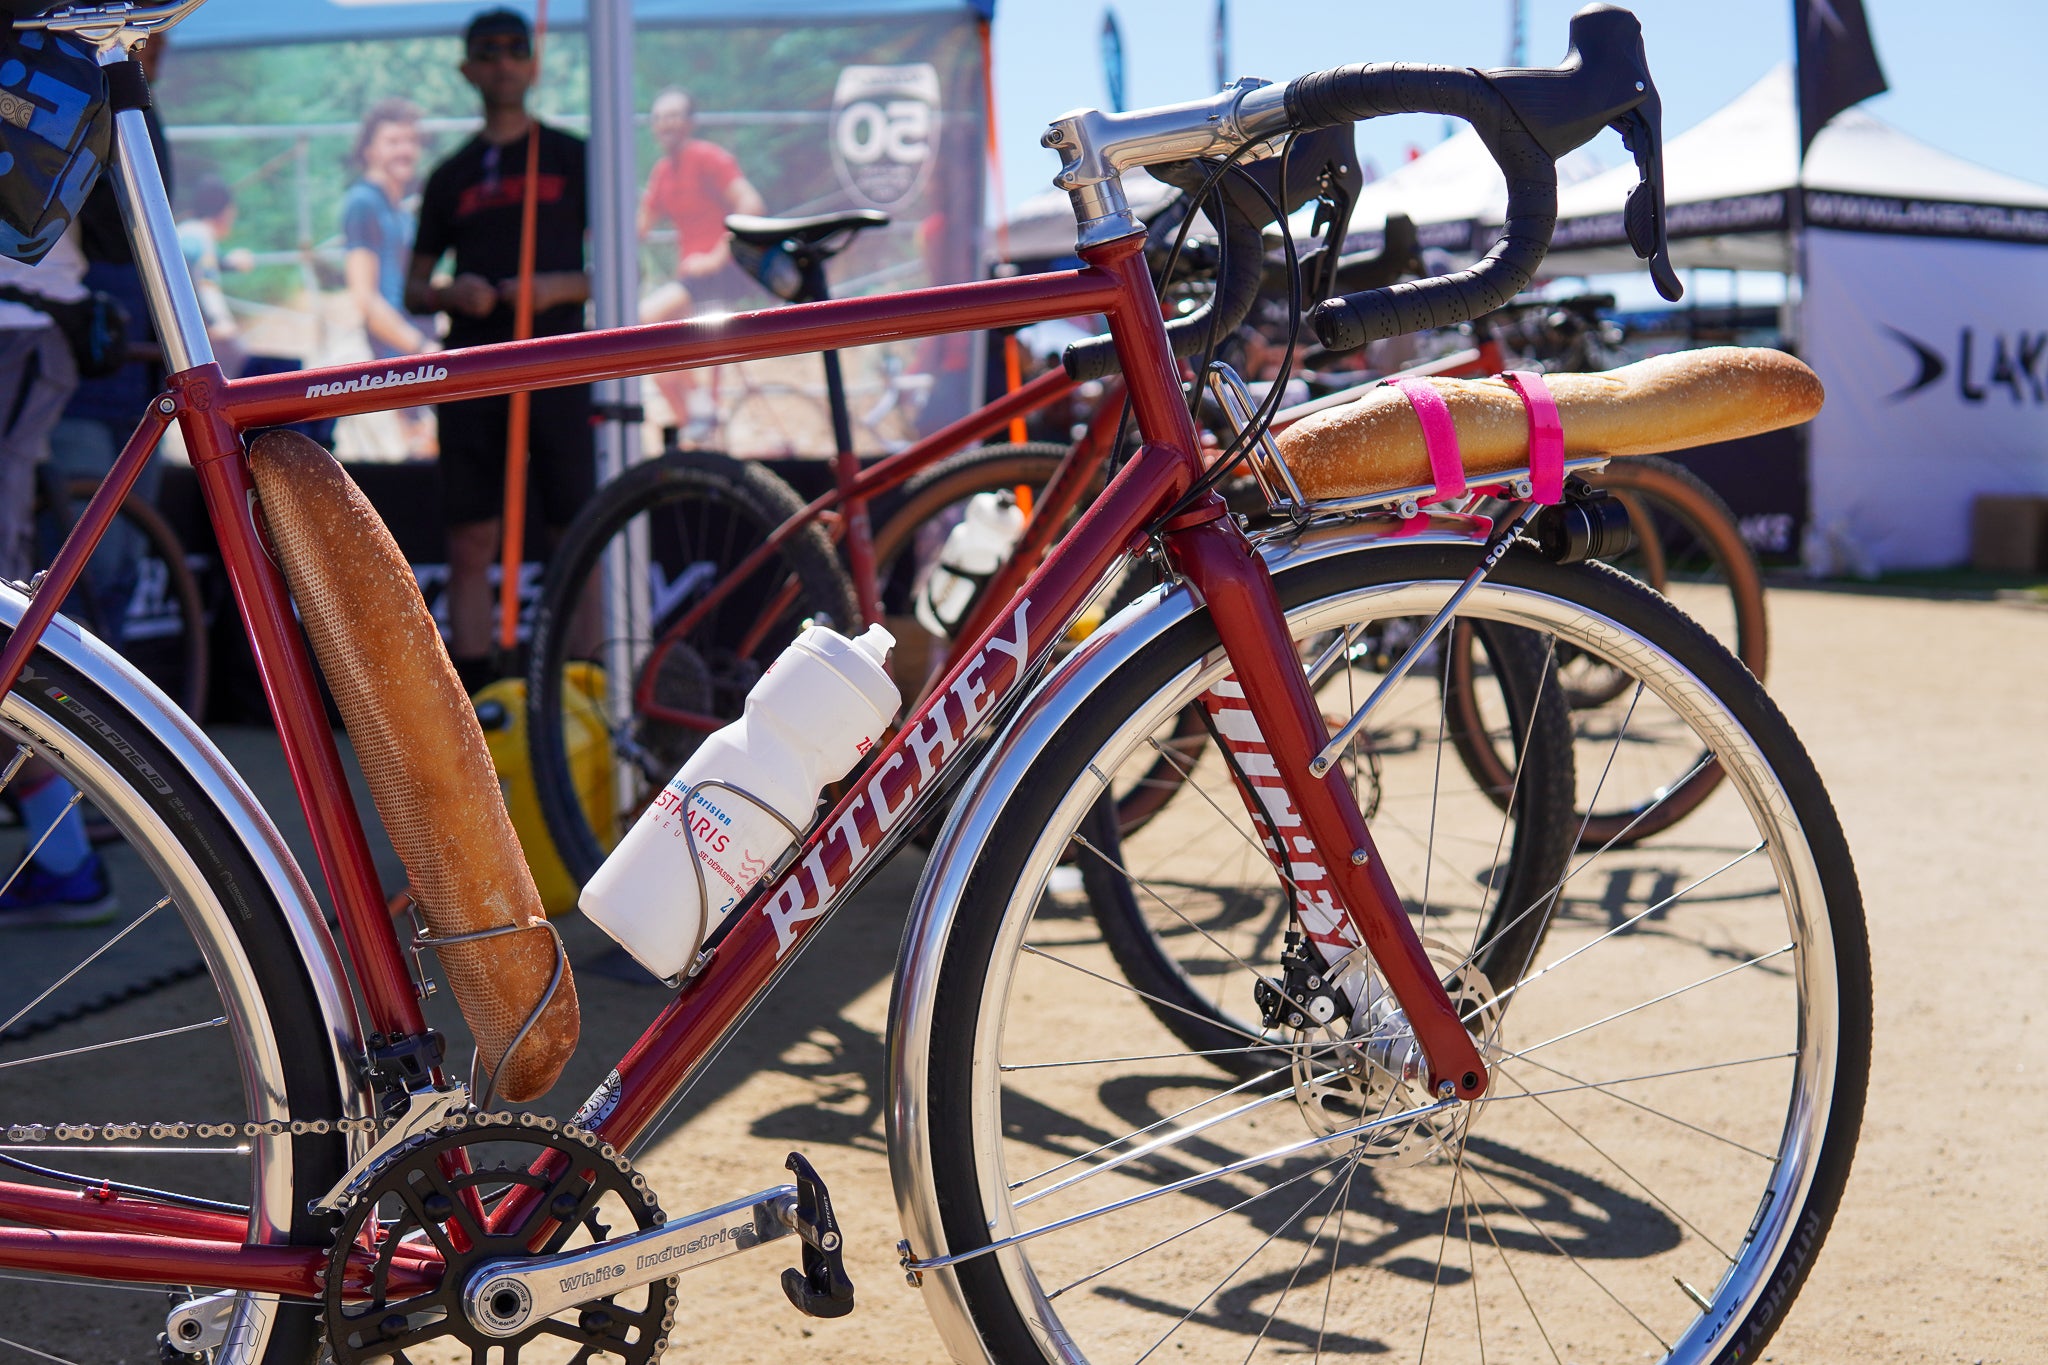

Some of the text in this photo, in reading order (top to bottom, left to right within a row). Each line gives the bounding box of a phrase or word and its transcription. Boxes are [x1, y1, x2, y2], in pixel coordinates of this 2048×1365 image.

[305, 364, 448, 399] montebello
[1485, 525, 1525, 567] SOMA
[7, 714, 66, 761] ZETA
[1557, 613, 1798, 831] RITCHEY
[82, 711, 147, 773] ALPINE
[141, 763, 170, 795] JB
[762, 597, 1032, 962] RITCHEY
[692, 791, 732, 826] Parisien
[698, 850, 709, 862] SE
[823, 1194, 833, 1229] RITCHEY
[559, 1221, 755, 1293] White Industries
[1749, 1208, 1822, 1345] RITCHEY
